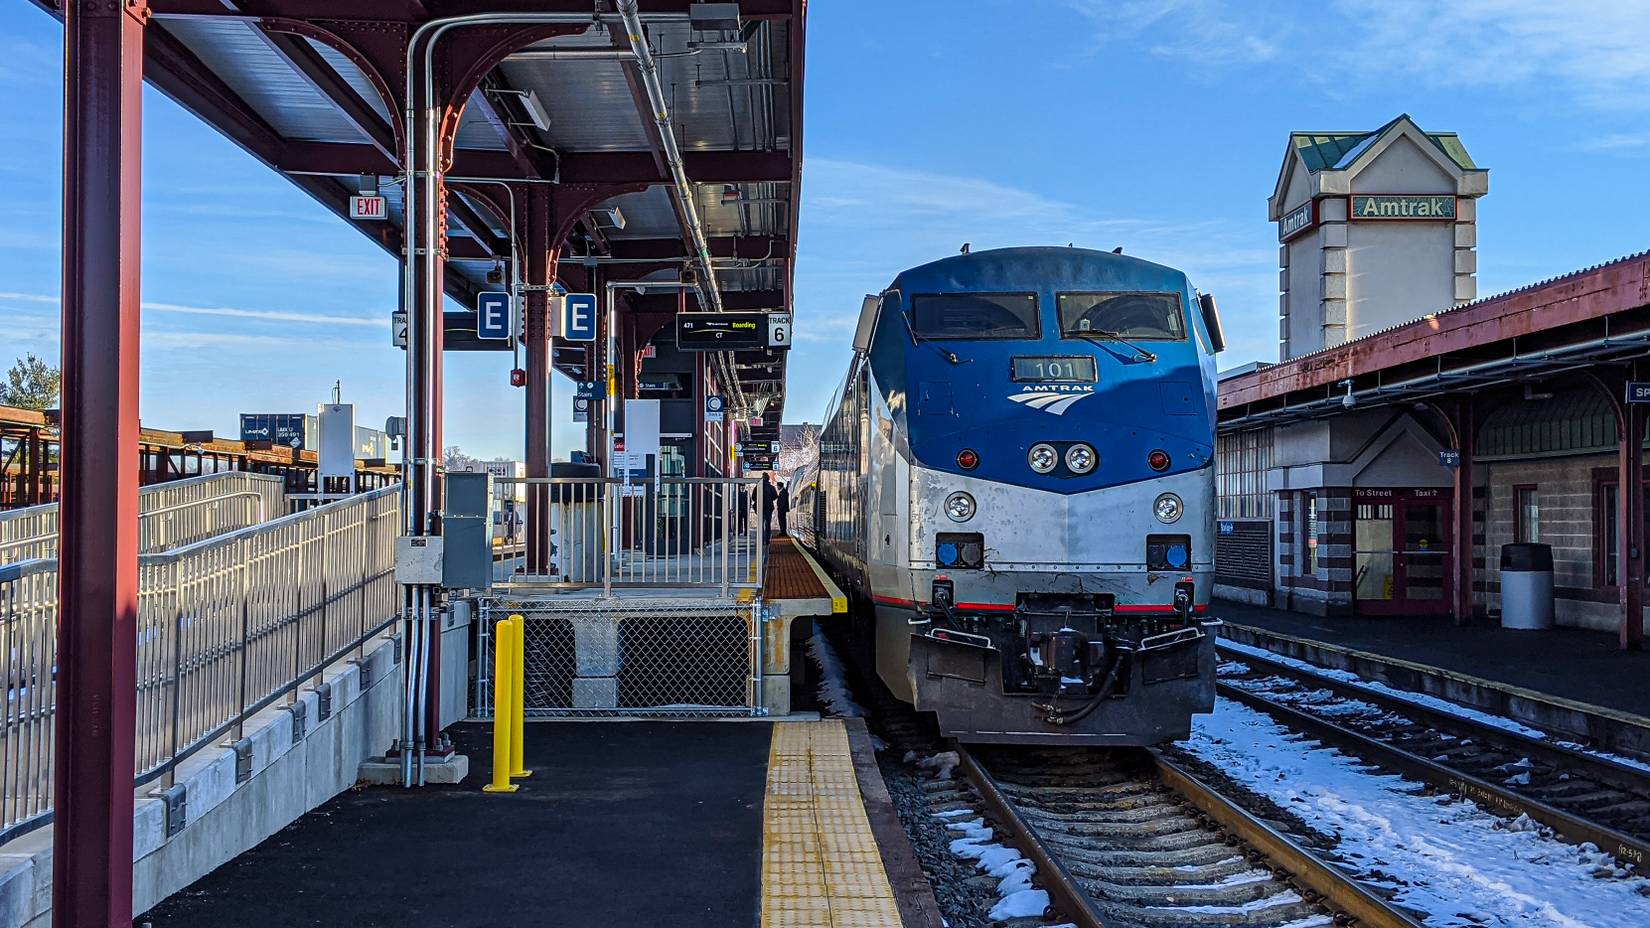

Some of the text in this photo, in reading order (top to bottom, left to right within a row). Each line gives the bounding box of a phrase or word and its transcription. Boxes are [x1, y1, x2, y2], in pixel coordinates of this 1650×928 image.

[357, 198, 381, 215] EXIT
[1363, 197, 1443, 216] Amtrak
[1282, 206, 1309, 235] Amtrak
[485, 301, 502, 330] E
[572, 303, 589, 331] E
[732, 322, 756, 330] Boarding
[398, 327, 408, 342] 4
[774, 327, 785, 342] 6
[1035, 362, 1074, 378] 101
[1355, 489, 1431, 497] To Street Taxi
